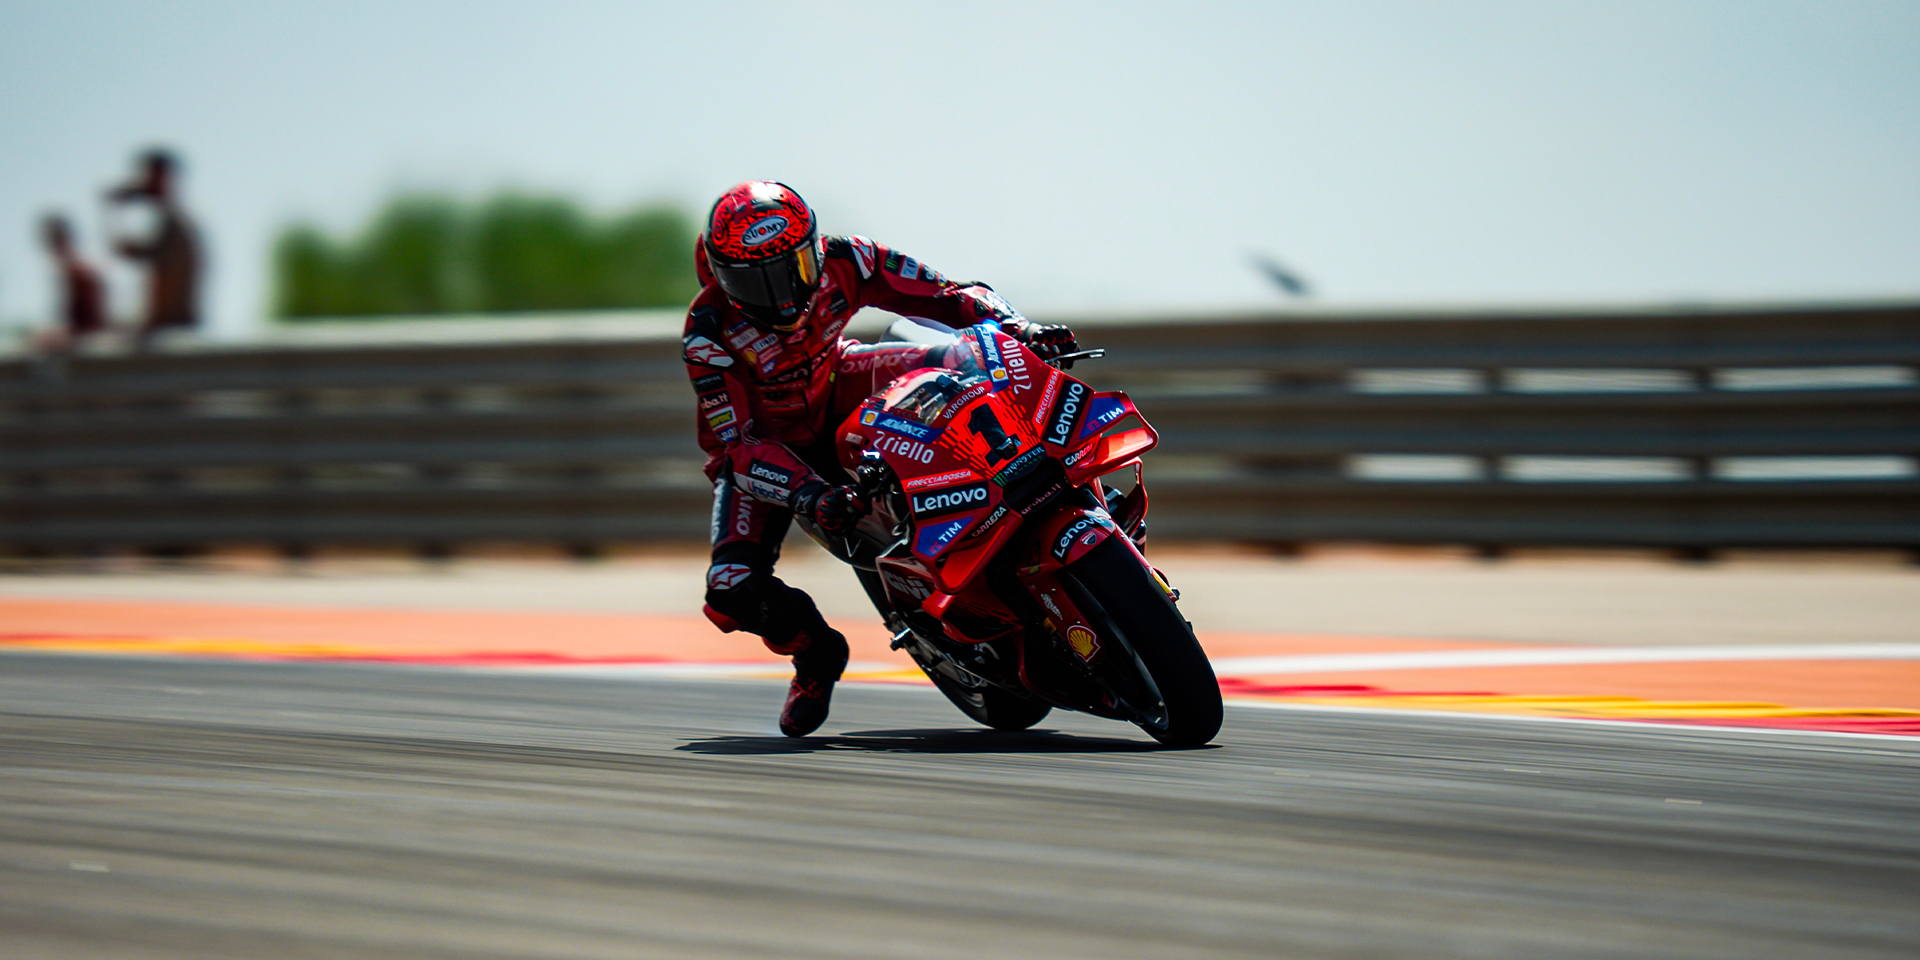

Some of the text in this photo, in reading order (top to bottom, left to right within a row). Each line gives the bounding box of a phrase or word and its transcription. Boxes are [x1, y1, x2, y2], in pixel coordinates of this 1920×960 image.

[745, 222, 785, 241] SUOMY
[942, 386, 985, 420] VARGROUP
[1035, 370, 1059, 425] FRECCIAROSSA
[1048, 382, 1084, 446] Lenovo
[1098, 407, 1124, 423] TIM
[879, 418, 929, 438] ADVANCE
[967, 403, 1022, 468] 1
[751, 463, 789, 484] Lenovo
[907, 470, 971, 488] FRECCIAROSSA
[912, 487, 988, 513] Lenovo
[1020, 482, 1061, 515] aruba.it
[938, 521, 962, 543] TIM
[971, 505, 1007, 538] CARRERA
